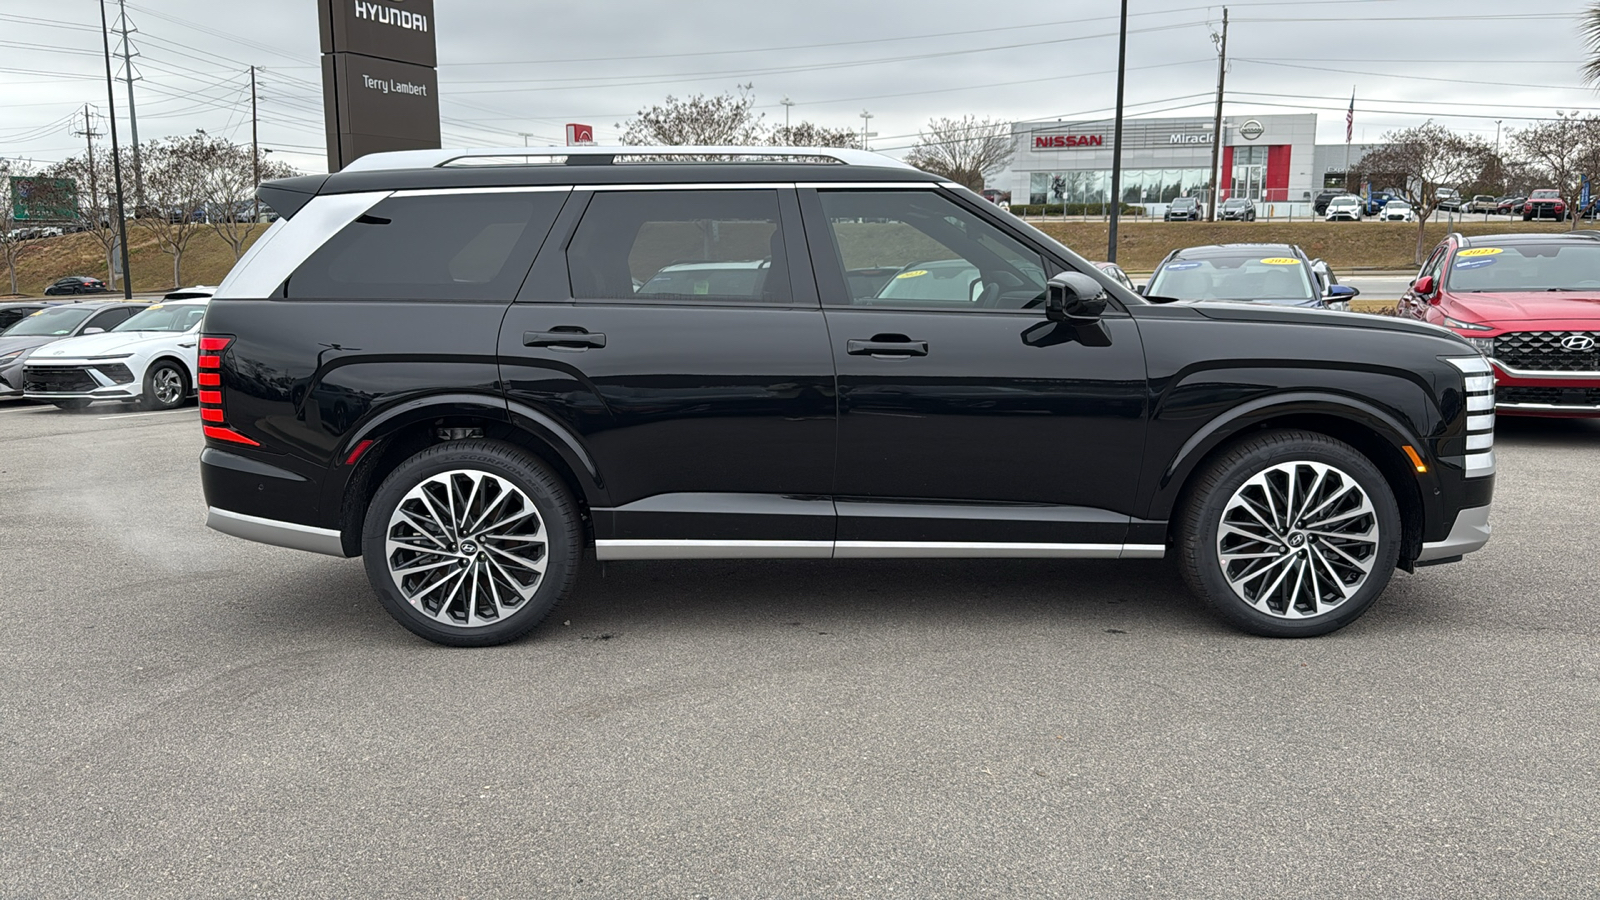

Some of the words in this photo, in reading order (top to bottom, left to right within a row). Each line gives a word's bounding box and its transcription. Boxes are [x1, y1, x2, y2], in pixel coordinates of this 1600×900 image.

[355, 0, 427, 32] HYUNDAI
[362, 74, 389, 94] Terry
[390, 79, 428, 97] Lambert
[1035, 135, 1103, 148] NISSAN
[459, 454, 524, 478] SCORPION
[525, 478, 544, 494] MS
